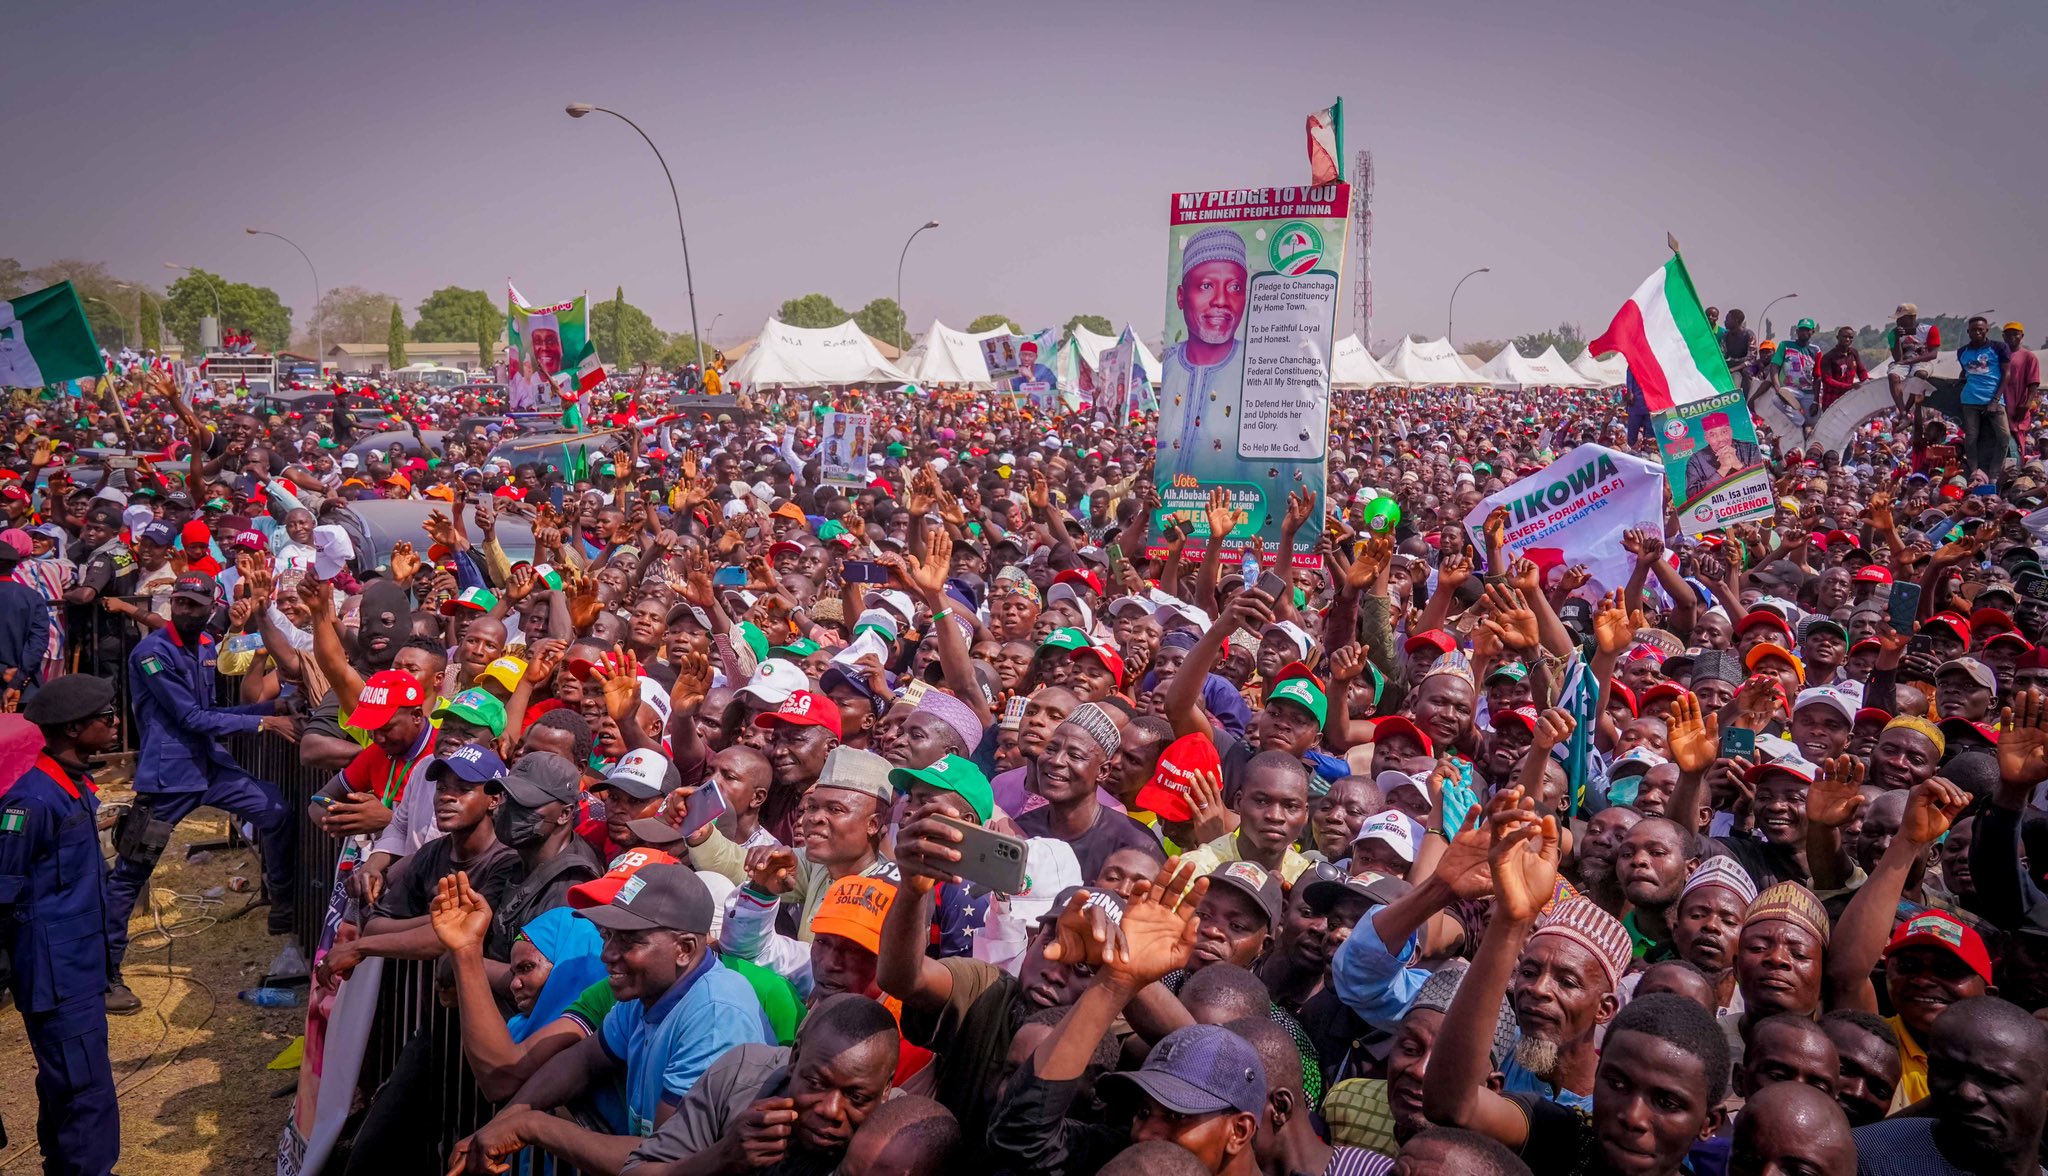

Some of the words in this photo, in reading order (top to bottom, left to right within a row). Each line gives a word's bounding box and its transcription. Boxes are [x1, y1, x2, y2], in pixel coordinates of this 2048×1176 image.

[1179, 193, 1206, 210] MY
[1207, 189, 1269, 208] PLEDGE
[1273, 187, 1296, 203] TO
[1300, 185, 1336, 203] YOU
[1180, 211, 1197, 221] THE
[1199, 208, 1241, 220] EMINENT
[1243, 206, 1279, 218] PEOPLE
[1281, 205, 1293, 215] OF
[1296, 205, 1331, 215] MINNA
[1258, 282, 1281, 292] Pledge
[1283, 282, 1290, 290] to
[1292, 281, 1334, 291] Chanchaga
[1253, 293, 1279, 302] Federal
[1280, 292, 1329, 302] Constituency
[1252, 304, 1262, 313] My
[1264, 304, 1285, 312] Home
[1286, 303, 1307, 311] Town.
[1250, 325, 1259, 333] To
[1260, 325, 1269, 333] be
[1270, 324, 1297, 333] Faithful
[1299, 324, 1320, 334] Loyal
[1249, 336, 1263, 344] and
[1264, 335, 1291, 344] Honest.
[1248, 357, 1257, 365] To
[1258, 356, 1278, 365] Serve
[1279, 356, 1321, 366] Chanchaga
[1247, 367, 1273, 376] Federal
[1274, 367, 1323, 377] Constituency
[1246, 378, 1262, 386] With
[1263, 378, 1273, 386] All
[1274, 378, 1285, 387] My
[1286, 377, 1321, 388] Strength.
[1245, 400, 1253, 408] To
[1255, 400, 1280, 408] Defend
[1281, 400, 1293, 408] Her
[1296, 400, 1316, 410] Unity
[1680, 392, 1740, 418] PAIKORO
[1244, 411, 1257, 419] and
[1258, 411, 1288, 420] Upholds
[1289, 411, 1302, 419] her
[1243, 422, 1256, 430] and
[1258, 421, 1279, 431] Glory.
[1242, 443, 1251, 452] So
[1253, 444, 1269, 453] Help
[1270, 444, 1281, 452] Me
[1282, 443, 1300, 452] God.
[1173, 473, 1199, 488] Vote.
[1239, 490, 1260, 502] Buba
[1504, 453, 1619, 530] TIKOWA
[1711, 493, 1728, 505] Alh.
[1729, 489, 1741, 500] Isa
[1743, 482, 1768, 496] Liman
[1548, 498, 1586, 525] FORUM
[1588, 478, 1625, 506] (A.B.F)
[1720, 496, 1769, 517] GOVERNOR
[1511, 534, 1537, 551] NIGER
[1538, 521, 1566, 540] STATE
[1567, 498, 1608, 526] CHAPTER
[1221, 539, 1244, 548] SOLID
